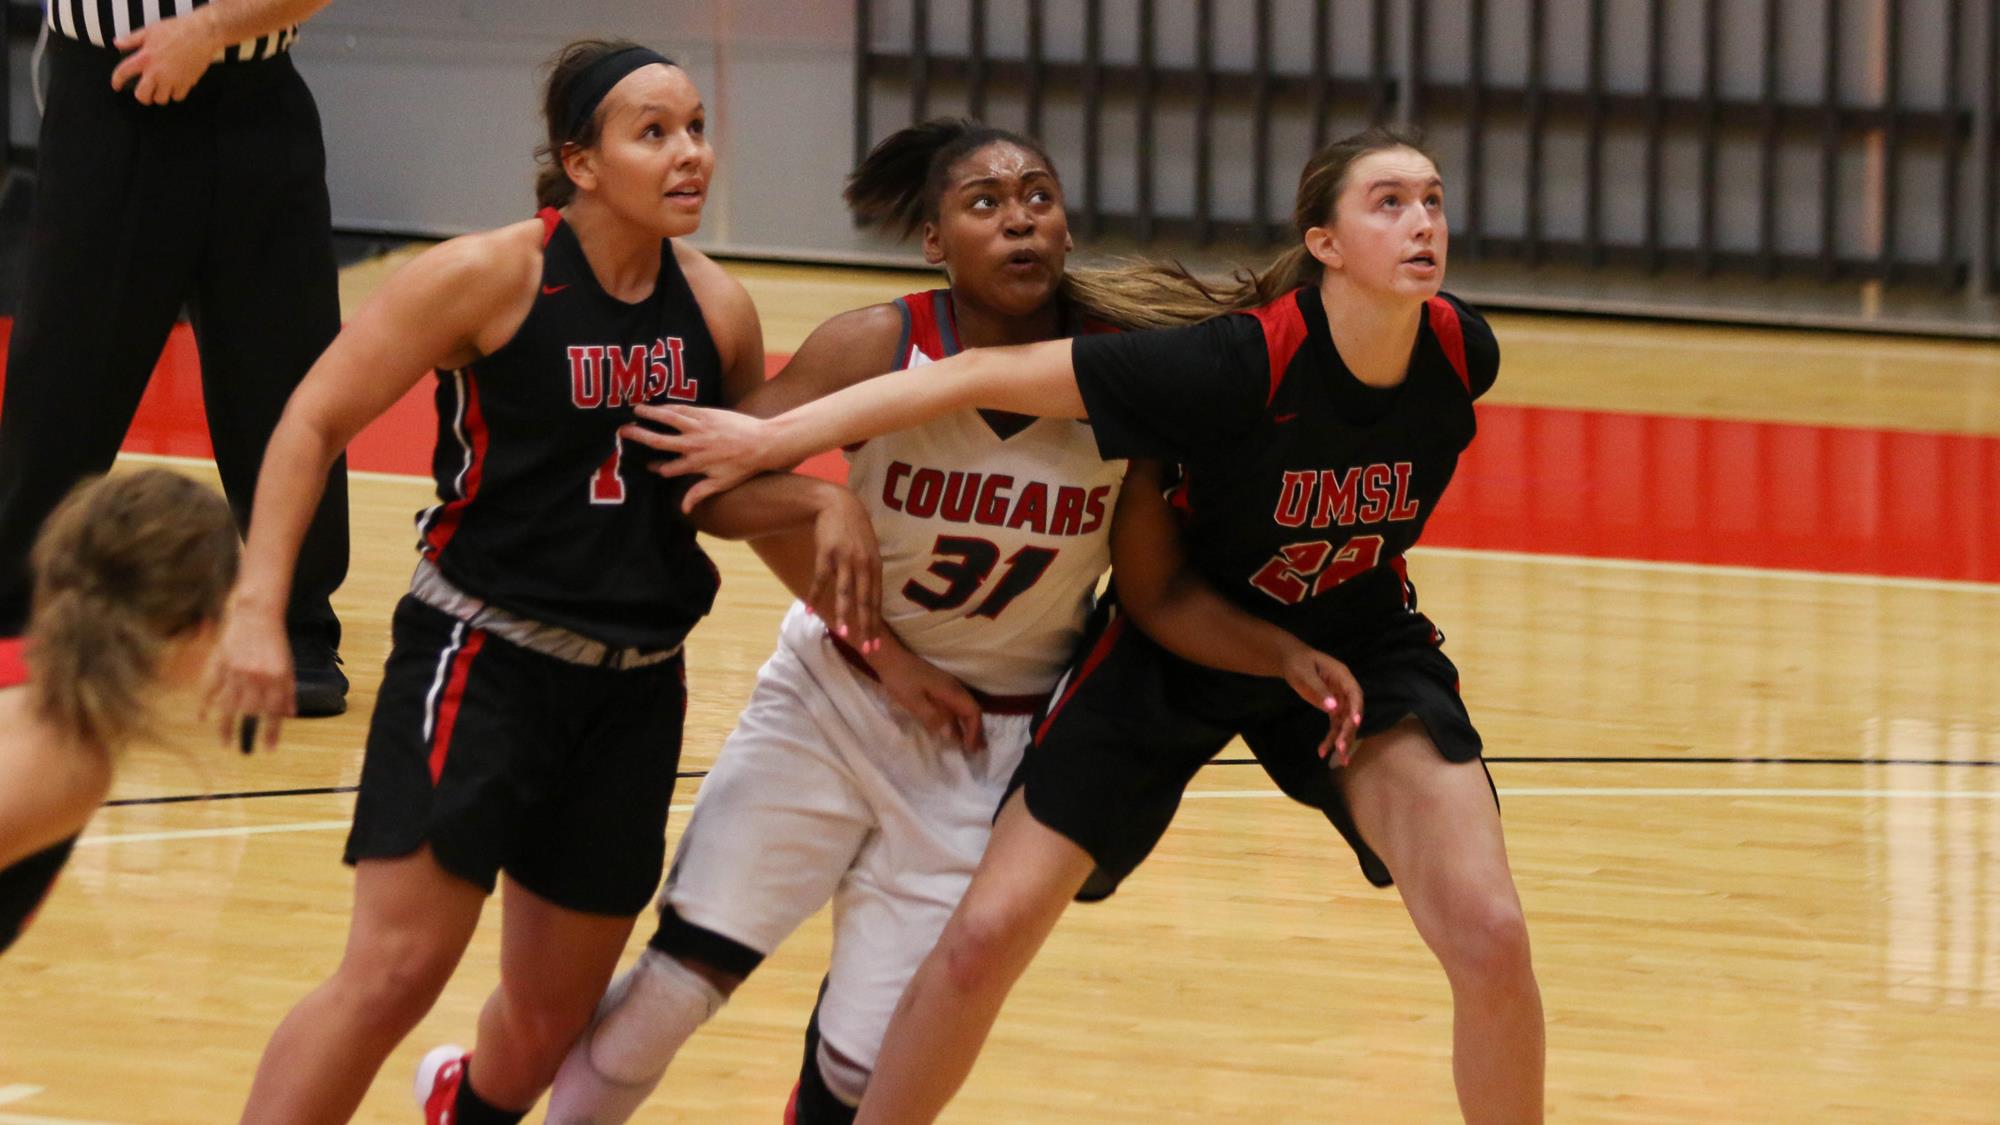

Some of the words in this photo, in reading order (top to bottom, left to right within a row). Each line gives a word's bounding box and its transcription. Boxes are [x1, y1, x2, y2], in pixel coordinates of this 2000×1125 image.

[567, 336, 698, 409] UMSL
[589, 421, 626, 504] 1
[882, 460, 1111, 536] COUGARS
[1273, 462, 1419, 528] UMSL
[901, 534, 1060, 621] 31
[1249, 534, 1384, 605] 22
